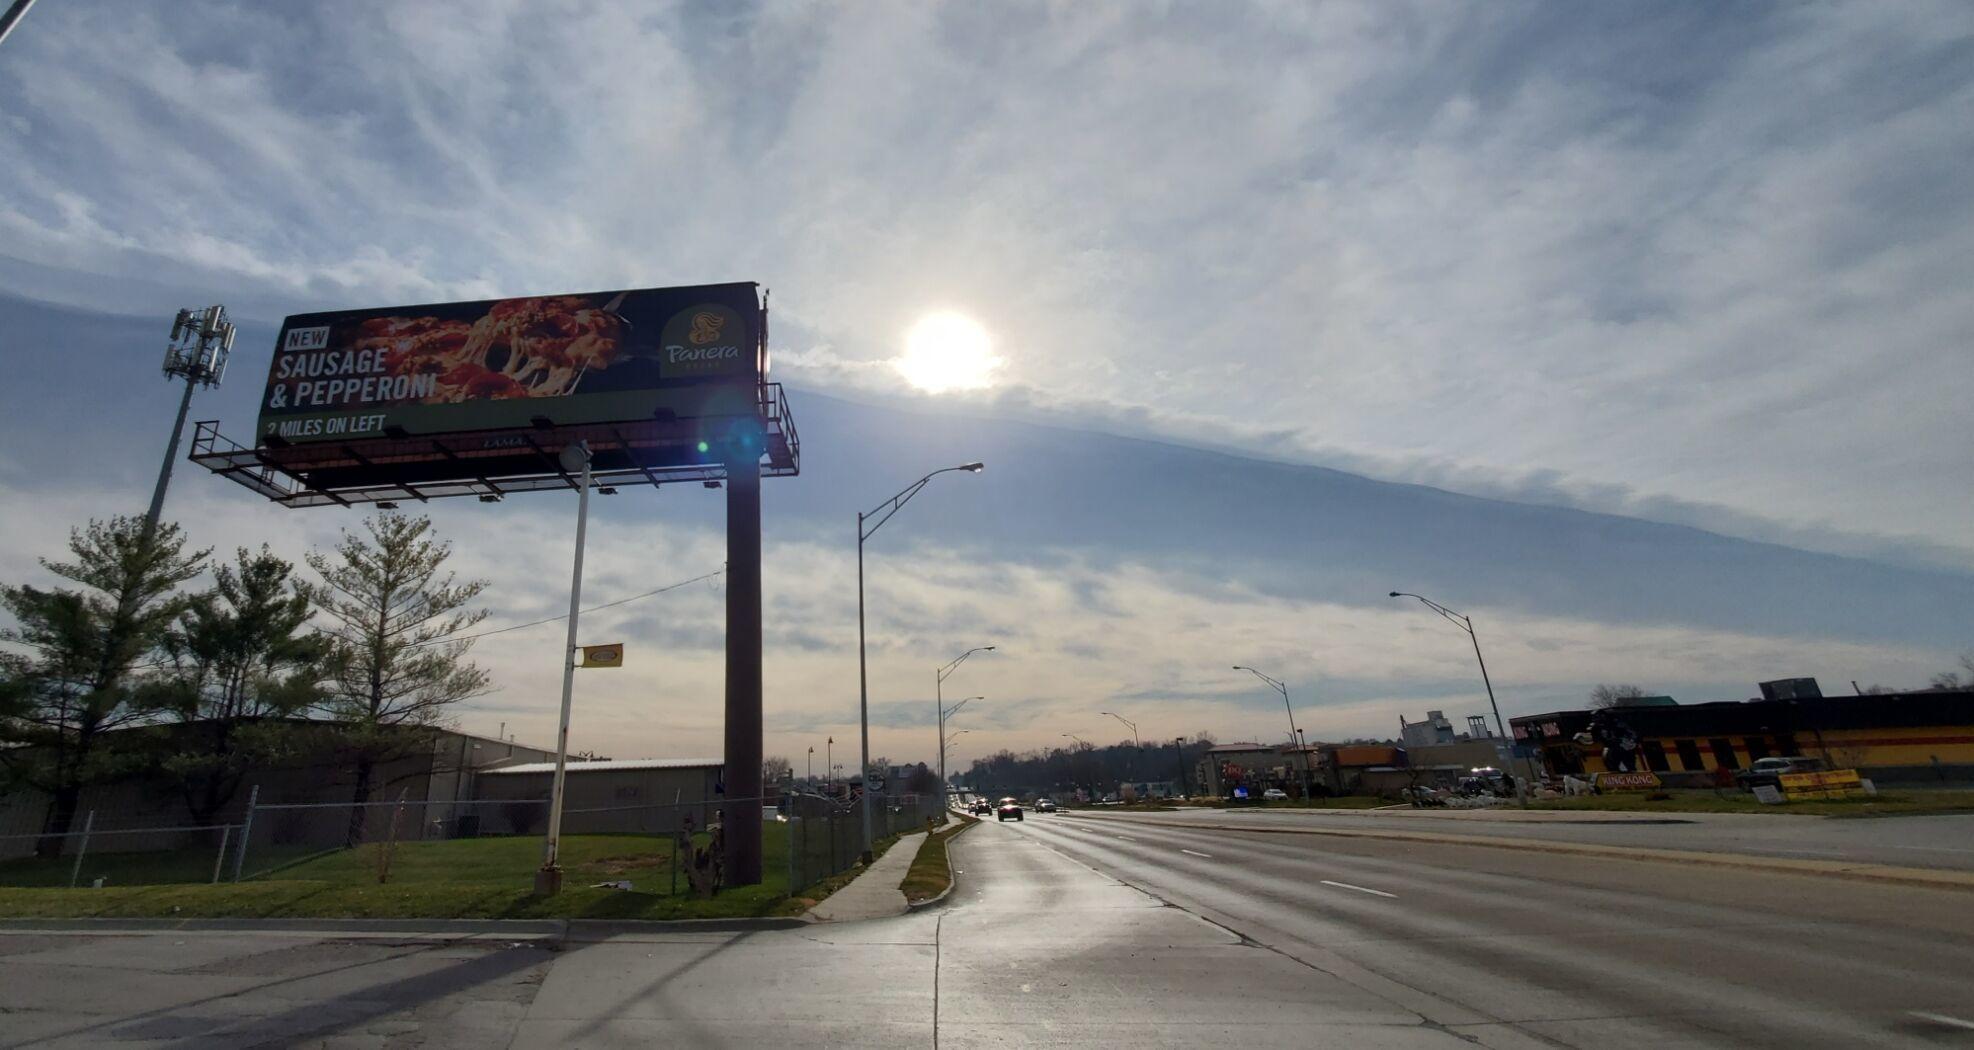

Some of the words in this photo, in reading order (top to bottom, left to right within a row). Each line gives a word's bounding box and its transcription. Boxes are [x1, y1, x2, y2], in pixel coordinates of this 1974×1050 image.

[288, 329, 327, 348] NEW
[276, 348, 389, 379] SAUSAGE
[665, 345, 739, 363] Panera
[269, 383, 287, 408] &
[294, 373, 437, 406] PEPPERONI
[267, 422, 277, 435] 2
[279, 419, 323, 437] MILES
[326, 417, 347, 434] ON
[350, 414, 386, 432] LEFT
[484, 437, 528, 449] LAMA
[1602, 776, 1625, 785] KING
[1626, 775, 1653, 785] KONG
